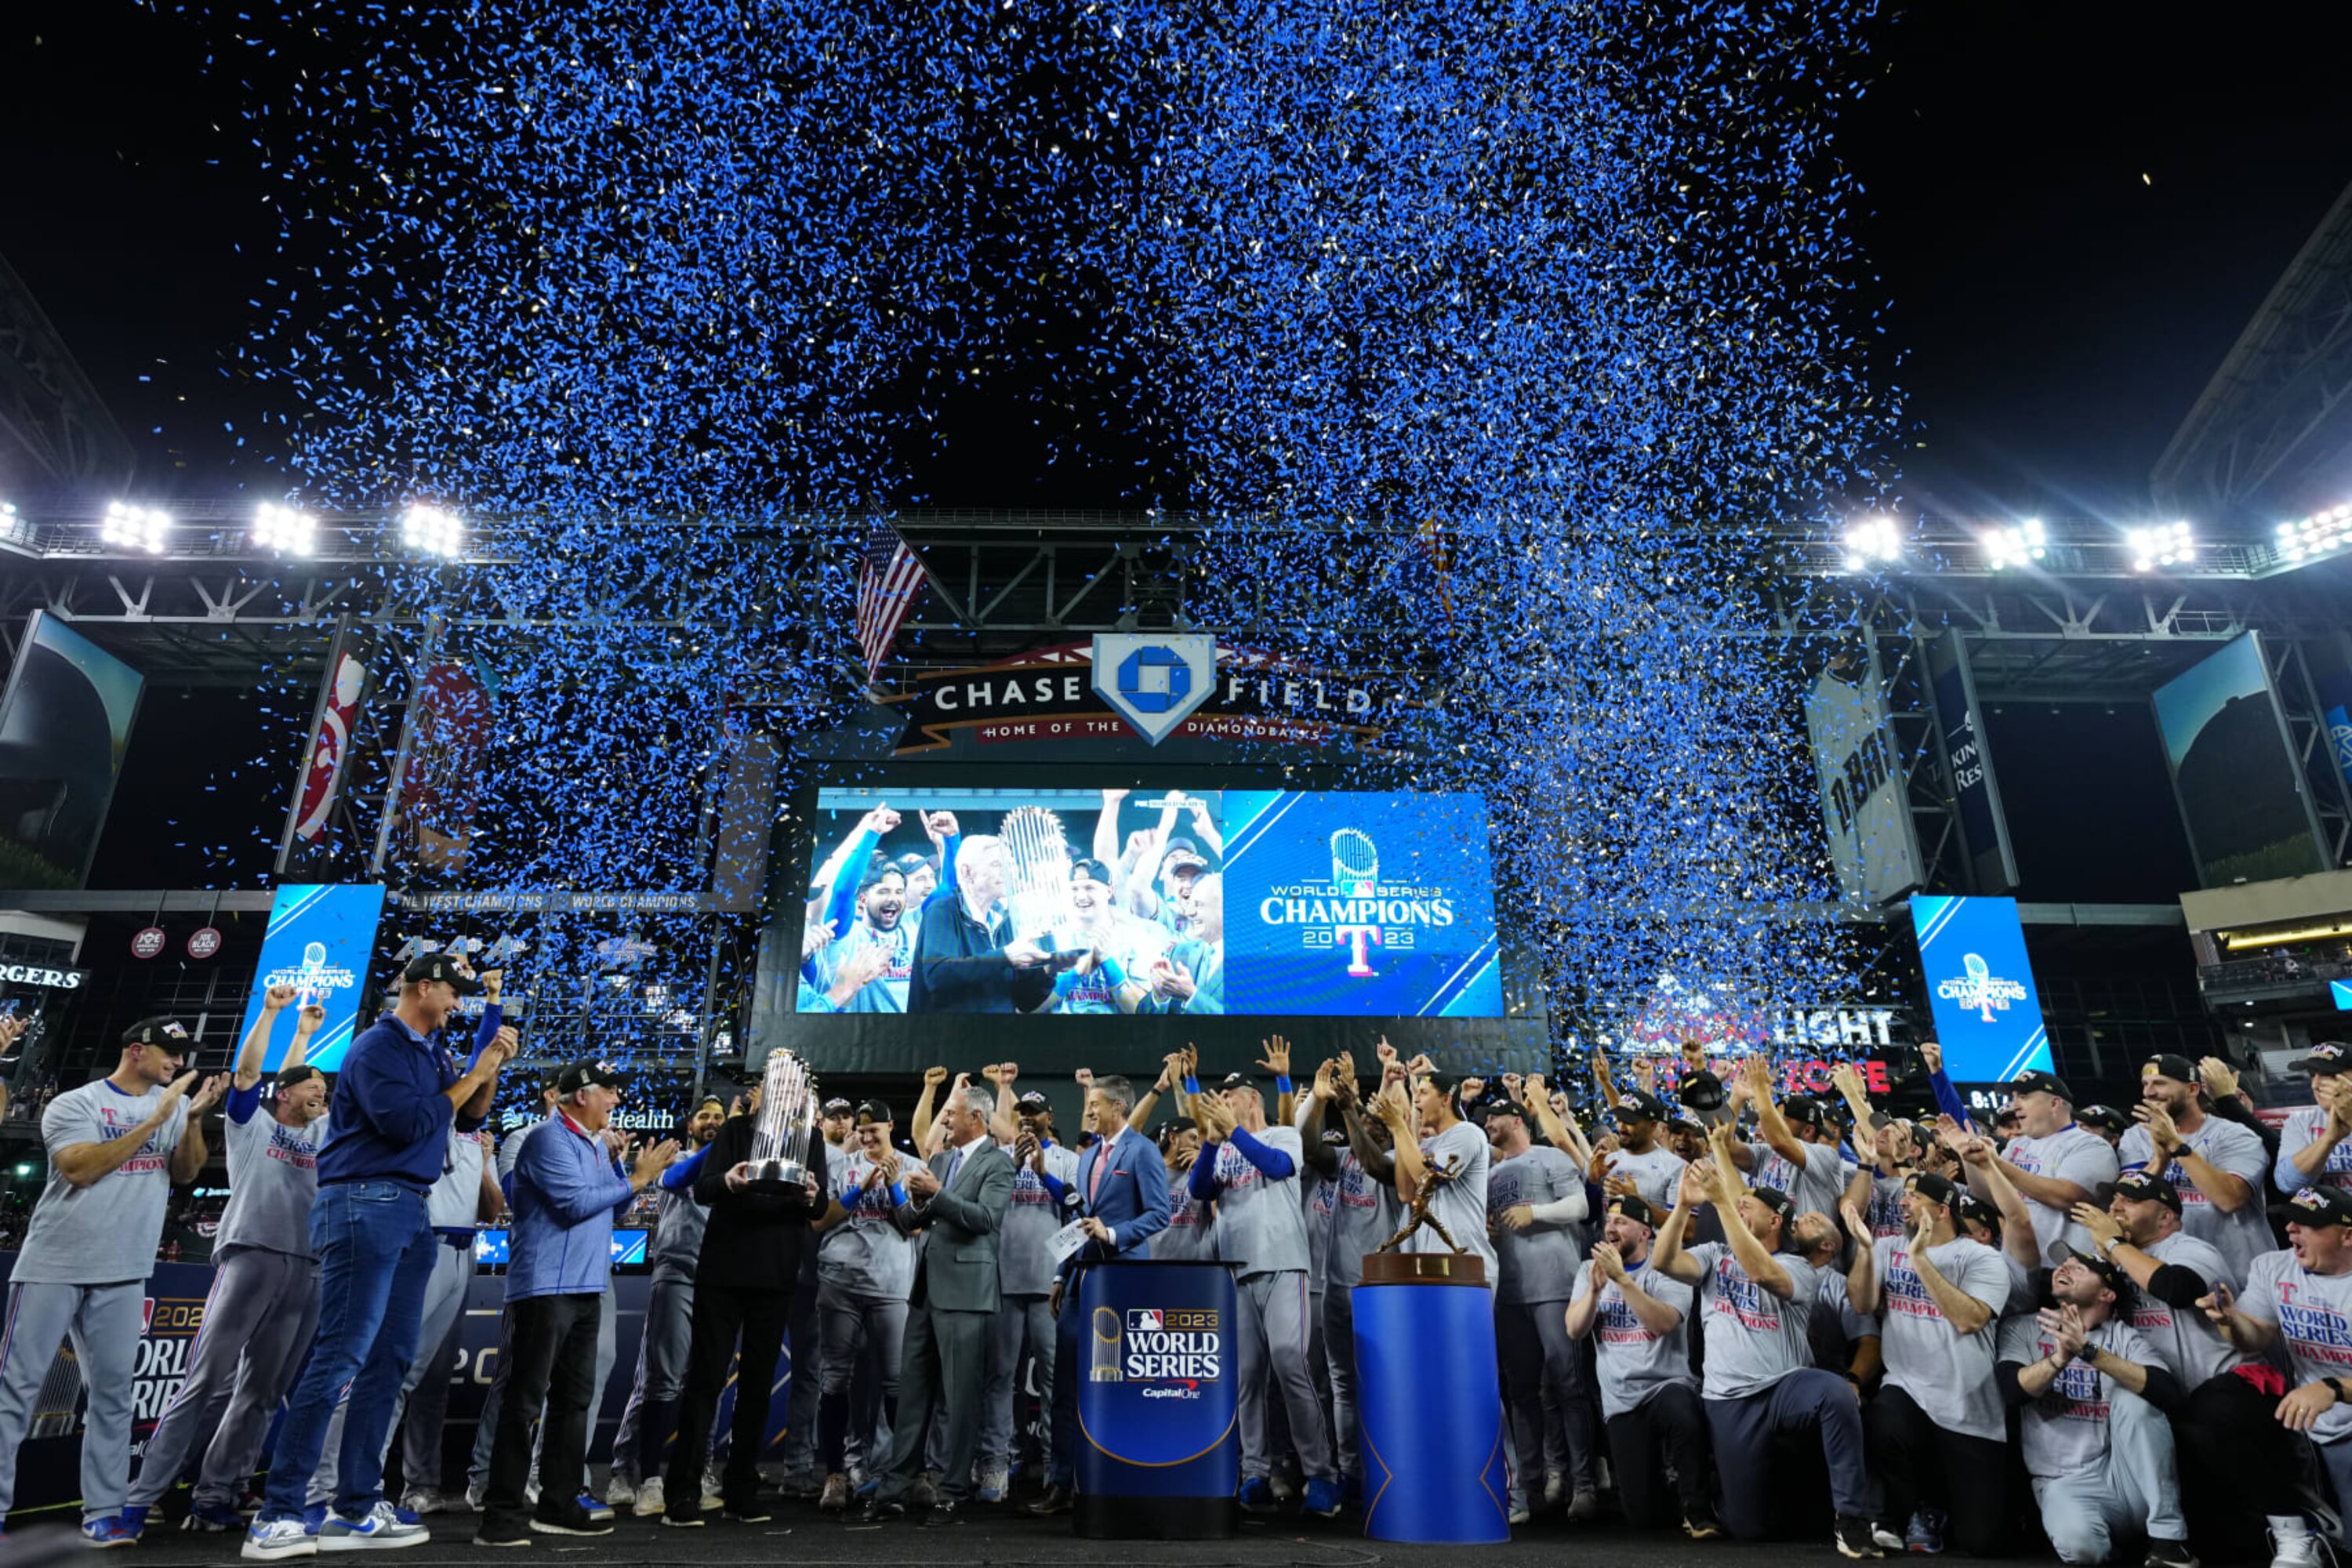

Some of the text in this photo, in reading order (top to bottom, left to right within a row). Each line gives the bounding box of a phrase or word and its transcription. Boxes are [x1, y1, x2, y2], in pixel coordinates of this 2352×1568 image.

[935, 677, 1371, 713] CHASE FIELD
[985, 721, 1320, 740] HOME OF THE DIAMONDBAKS
[401, 895, 543, 908] NL WEST CHAMPIONS
[572, 895, 696, 908] WORLD CHAMPIONS
[1270, 885, 1443, 898] WORLD SERIES
[1259, 897, 1455, 927] CHAMPIONS
[1303, 931, 1414, 945] 20 23
[263, 974, 355, 988] CHAMPIONS
[1937, 984, 2027, 1000] CHAMPIONS
[1773, 1010, 1893, 1046] LIGHT
[608, 1109, 674, 1129] Health
[2277, 1281, 2298, 1305] T
[154, 1305, 205, 1327] 202
[1165, 1313, 1219, 1327] 2023
[2278, 1305, 2348, 1332] WORLD
[1126, 1331, 1221, 1354] WORLD
[132, 1338, 189, 1377] ORL
[1127, 1354, 1221, 1378] SERIES
